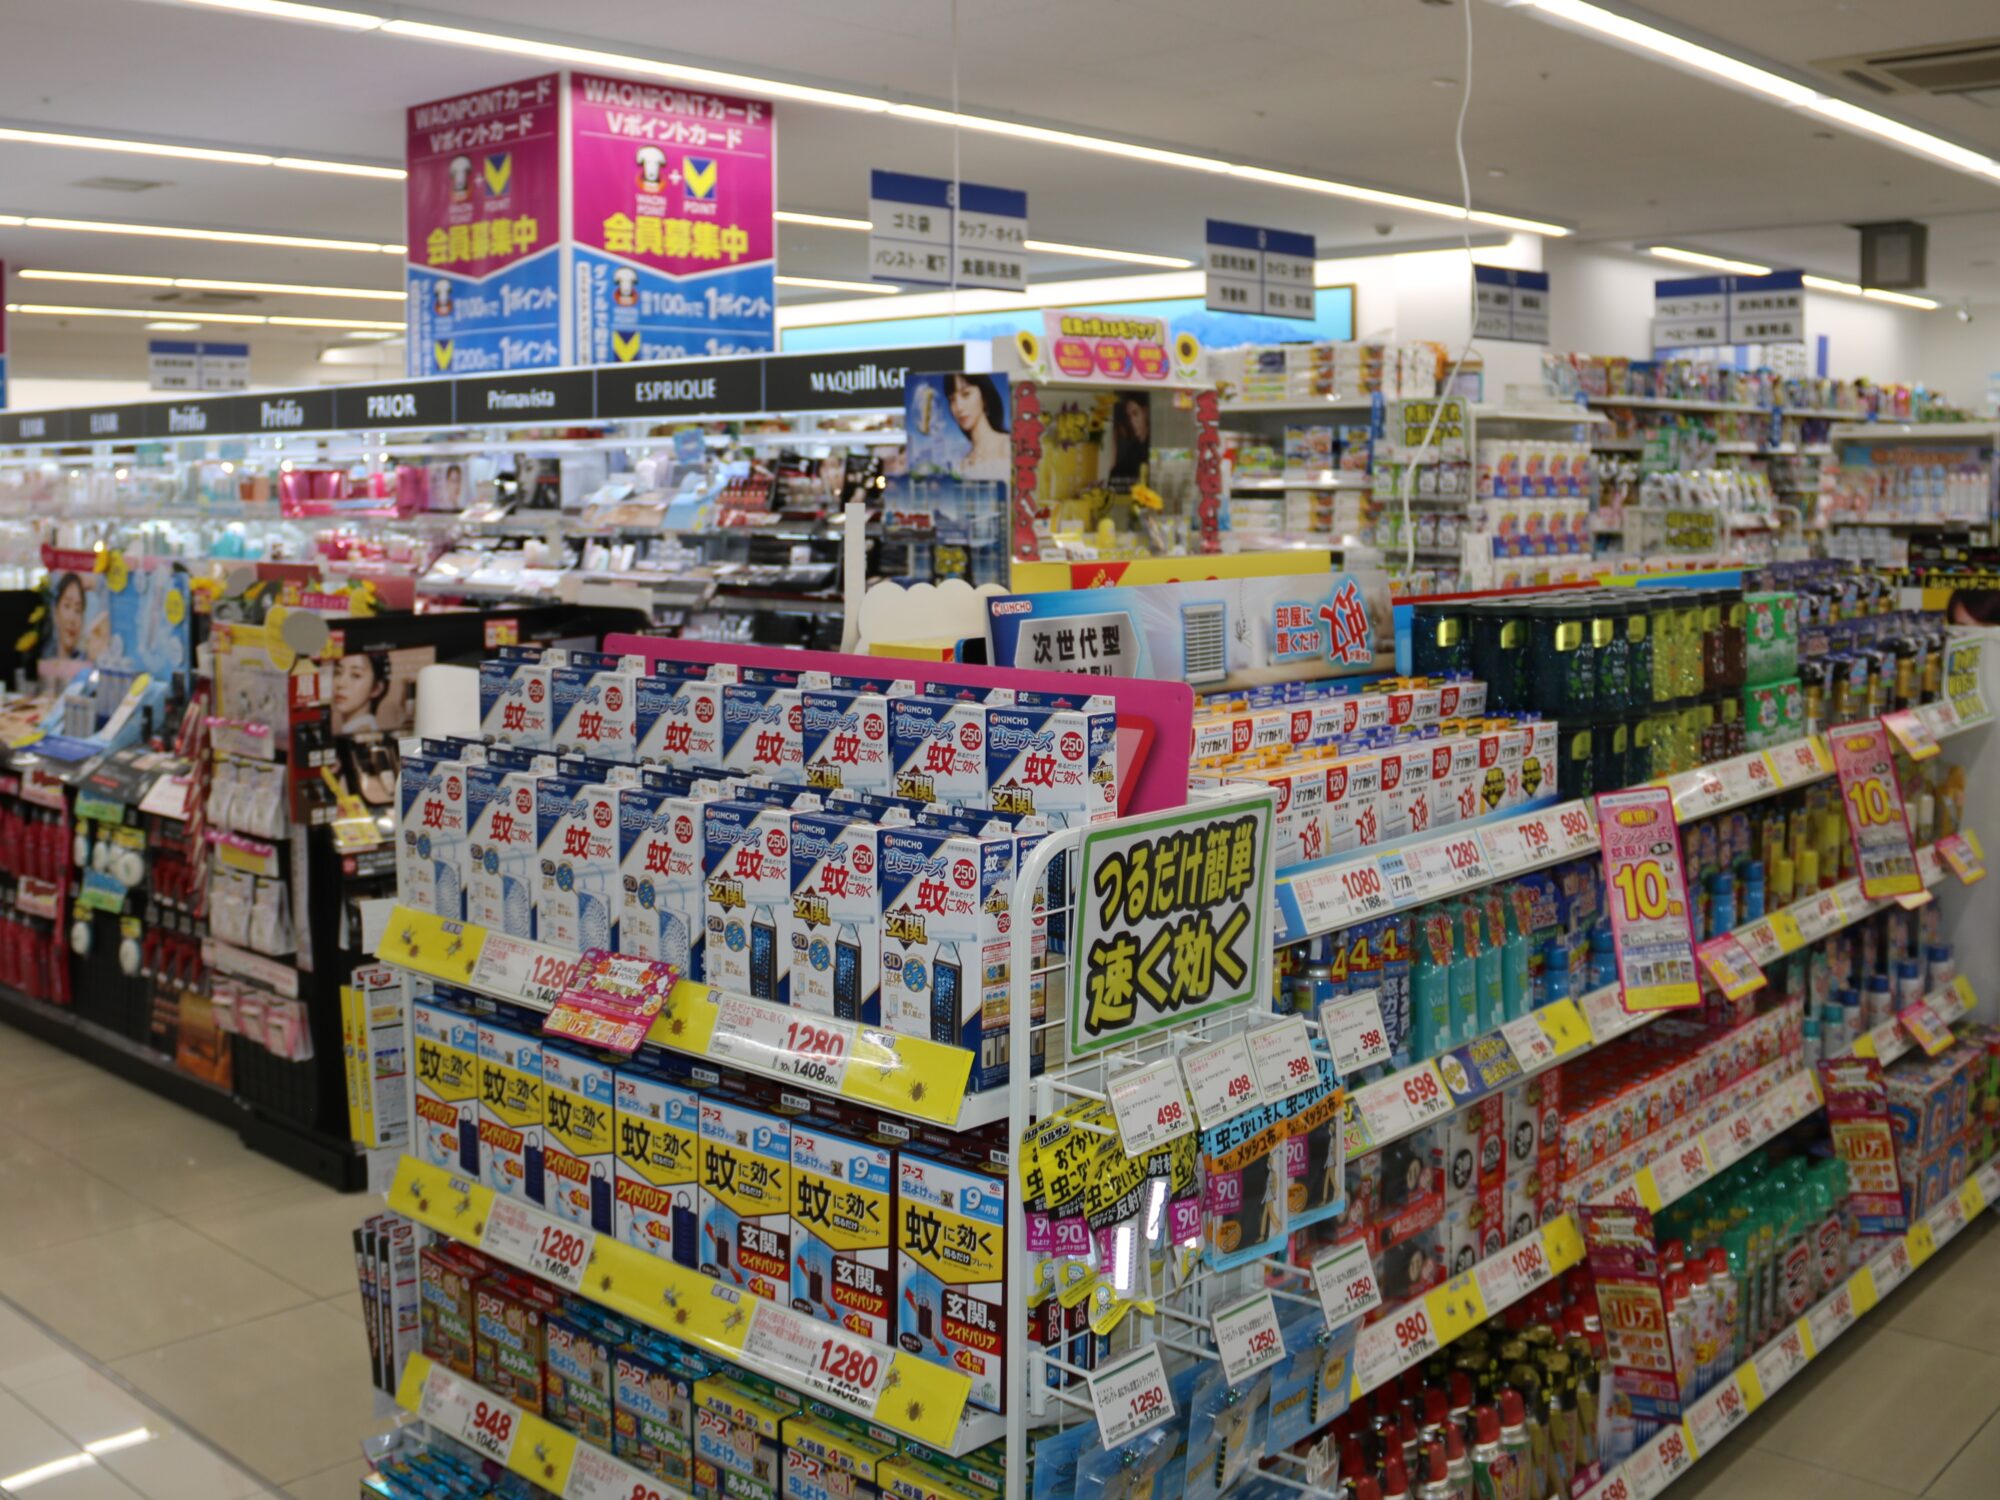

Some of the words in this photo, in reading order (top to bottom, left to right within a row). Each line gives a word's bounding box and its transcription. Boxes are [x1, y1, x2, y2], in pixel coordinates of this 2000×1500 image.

[583, 78, 763, 123] WAONPOINTカード
[430, 112, 534, 152] Vポイントカード
[606, 111, 743, 149] Vポイントカード
[427, 215, 538, 266] 会員募集中
[602, 212, 748, 261] 会員募集中
[487, 388, 556, 409] Primavista
[635, 379, 717, 401] ESPRIQUE
[367, 394, 416, 420] PRIOR
[1276, 607, 1312, 628] 部屋に
[1033, 625, 1121, 664] 次世代型
[1276, 633, 1319, 655] 置くだけ
[696, 702, 714, 715] 250
[903, 706, 932, 716] KINCHO
[998, 715, 1029, 726] KINCHO
[664, 721, 715, 755] 蚊に効く
[864, 718, 884, 731] 250
[897, 715, 957, 741] 虫コナーズ
[961, 729, 982, 740] 250
[991, 727, 1056, 752] 虫コナーズ
[1234, 727, 1250, 741] 120
[1294, 720, 1309, 734] 200
[832, 733, 883, 766] 蚊に効く
[1062, 736, 1084, 750] 250
[925, 742, 981, 776] 蚊に効く
[1022, 753, 1083, 788] 蚊に効く
[1383, 765, 1399, 780] 200
[807, 763, 844, 789] 玄関
[897, 771, 937, 804] 玄関
[1329, 775, 1344, 789] 120
[594, 808, 611, 823] 250
[714, 810, 740, 821] KINCHO
[992, 785, 1036, 816] 玄関
[675, 823, 693, 837] 250
[800, 824, 826, 836] KINCHO
[1519, 821, 1549, 849] 798
[1560, 810, 1589, 835] 980
[563, 824, 613, 860] 蚊に効く
[767, 833, 788, 850] 250
[791, 833, 849, 863] 虫コナーズ
[892, 837, 923, 850] KINCHO
[645, 839, 694, 877] 蚊に効く
[734, 847, 788, 882] 蚊に効く
[852, 850, 874, 867] 250
[885, 849, 949, 879] 虫コナーズ
[953, 863, 977, 880] 250
[1095, 815, 1258, 931] つるだけ簡単
[708, 877, 746, 909] 玄関
[819, 863, 873, 899] 蚊に効く
[793, 893, 831, 926] 玄関
[914, 879, 976, 916] 蚊に効く
[885, 909, 929, 945] 玄関
[1349, 936, 1370, 971] 4
[1382, 927, 1399, 961] 4
[884, 953, 902, 971] 3D
[1085, 902, 1250, 1036] 速く効く
[1332, 946, 1347, 982] 4
[1359, 1029, 1382, 1051] 398
[419, 1043, 473, 1085] 蚊に効く
[1287, 1056, 1311, 1078] 398
[483, 1065, 540, 1109] 蚊に効く
[618, 1080, 637, 1097] アース
[1228, 1074, 1252, 1099] 498
[1287, 1074, 1341, 1117] 虫こないもん
[1403, 1071, 1438, 1104] 698
[548, 1091, 606, 1136] 蚊に効く
[702, 1107, 722, 1122] アース
[1157, 1101, 1183, 1127] 498
[621, 1118, 693, 1166] 蚊に効く
[795, 1135, 815, 1151] アース
[879, 1122, 910, 1139] 無臭タイプ
[1039, 1123, 1072, 1148] バルサン
[1215, 1108, 1284, 1154] 虫こないもん
[705, 1146, 782, 1196] 蚊に効く
[902, 1163, 924, 1180] アース
[1087, 1157, 1147, 1214] 虫こないもん
[617, 1179, 671, 1215] ワイドバリア
[797, 1175, 880, 1228] 蚊に効く
[1216, 1180, 1238, 1201] 90
[905, 1205, 993, 1261] 蚊に効く
[1056, 1224, 1083, 1244] 90
[1177, 1209, 1198, 1230] 90
[741, 1225, 785, 1260] 玄関を
[943, 1248, 971, 1266] 吊るだけ
[741, 1251, 785, 1277] ワイドバリア
[836, 1260, 883, 1296] 玄関を
[835, 1287, 884, 1313] ワイドバリア
[946, 1293, 997, 1332] 玄関を
[946, 1322, 997, 1349] ワイドバリア
[1395, 1310, 1428, 1348] 980
[618, 1359, 646, 1389] アース
[473, 1401, 513, 1442] 948
[698, 1409, 729, 1439] アース
[1658, 1432, 1684, 1466] 598
[788, 1450, 820, 1480] アース
